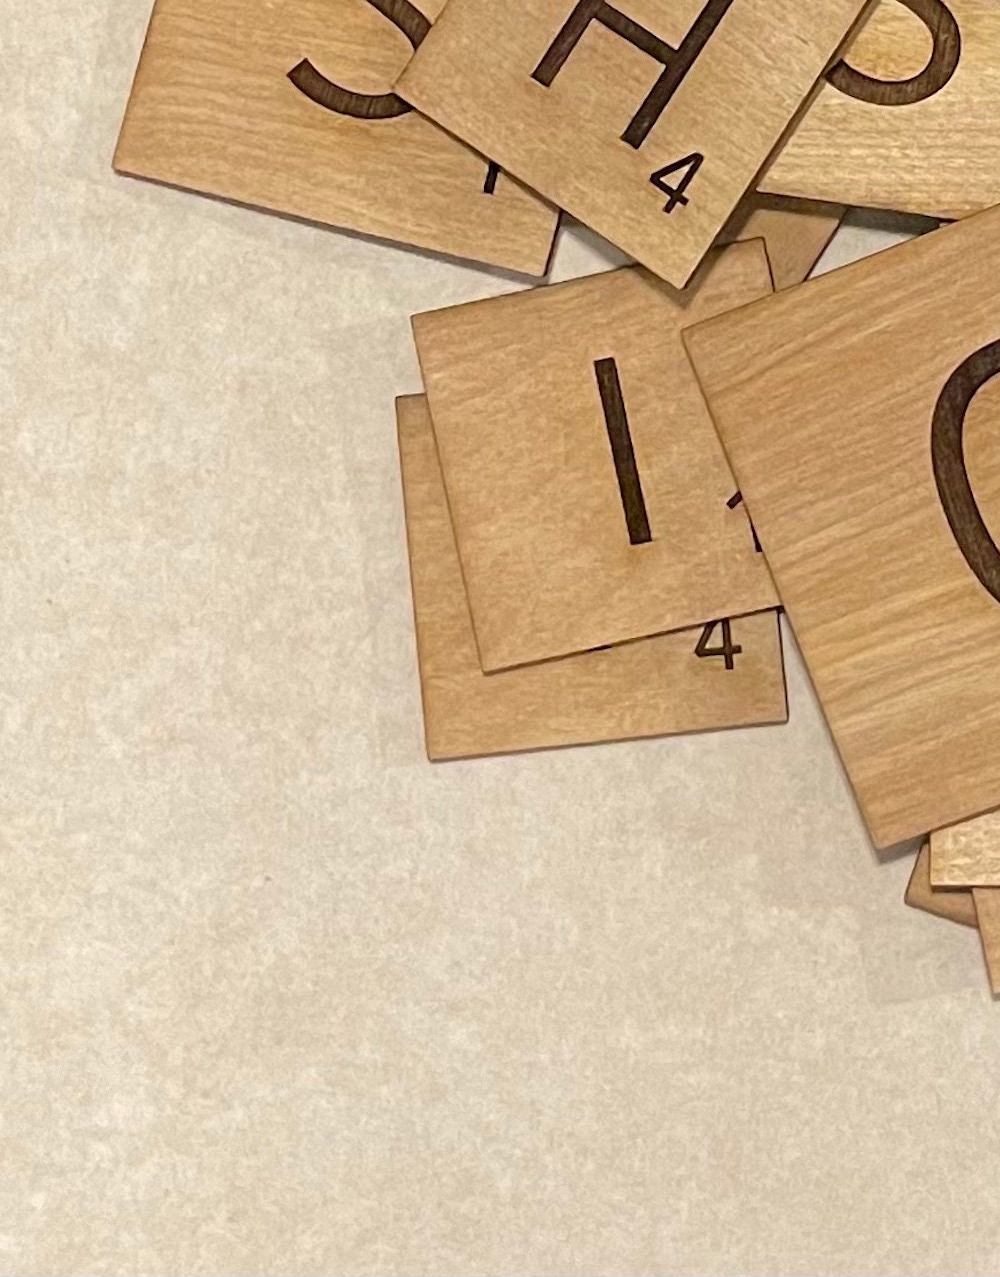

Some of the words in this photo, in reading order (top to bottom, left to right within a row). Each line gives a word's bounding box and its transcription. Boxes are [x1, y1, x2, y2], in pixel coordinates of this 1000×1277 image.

[649, 153, 705, 214] 4
[593, 356, 653, 545] I
[694, 619, 742, 670] 4
